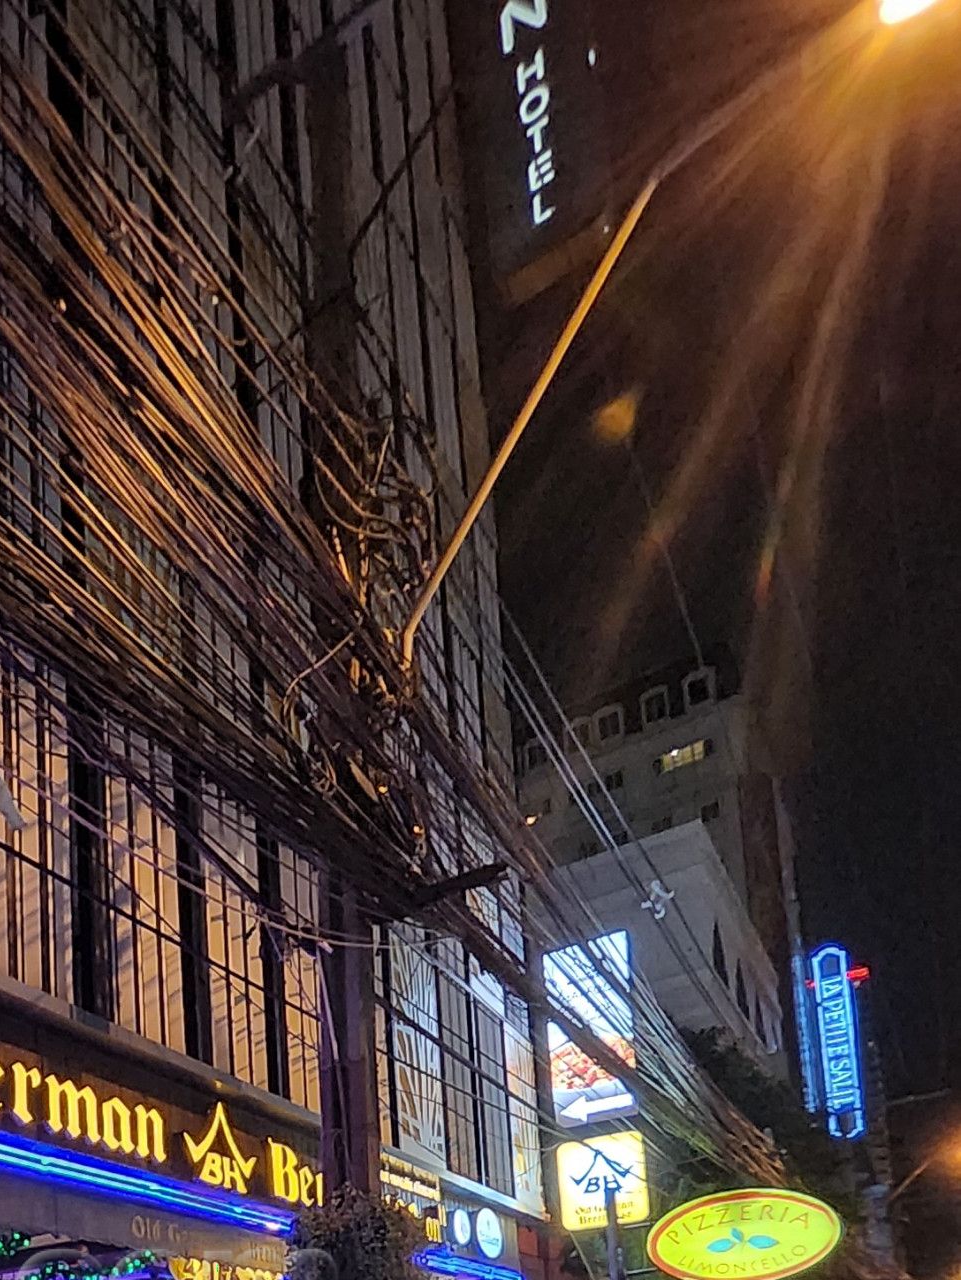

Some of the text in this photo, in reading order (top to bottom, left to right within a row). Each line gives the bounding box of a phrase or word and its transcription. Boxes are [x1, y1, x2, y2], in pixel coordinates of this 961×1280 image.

[516, 46, 556, 226] HOTEL
[201, 1152, 247, 1194] BH
[666, 1204, 811, 1245] PIZZERIA
[678, 1244, 807, 1275] LIMONCELLO
